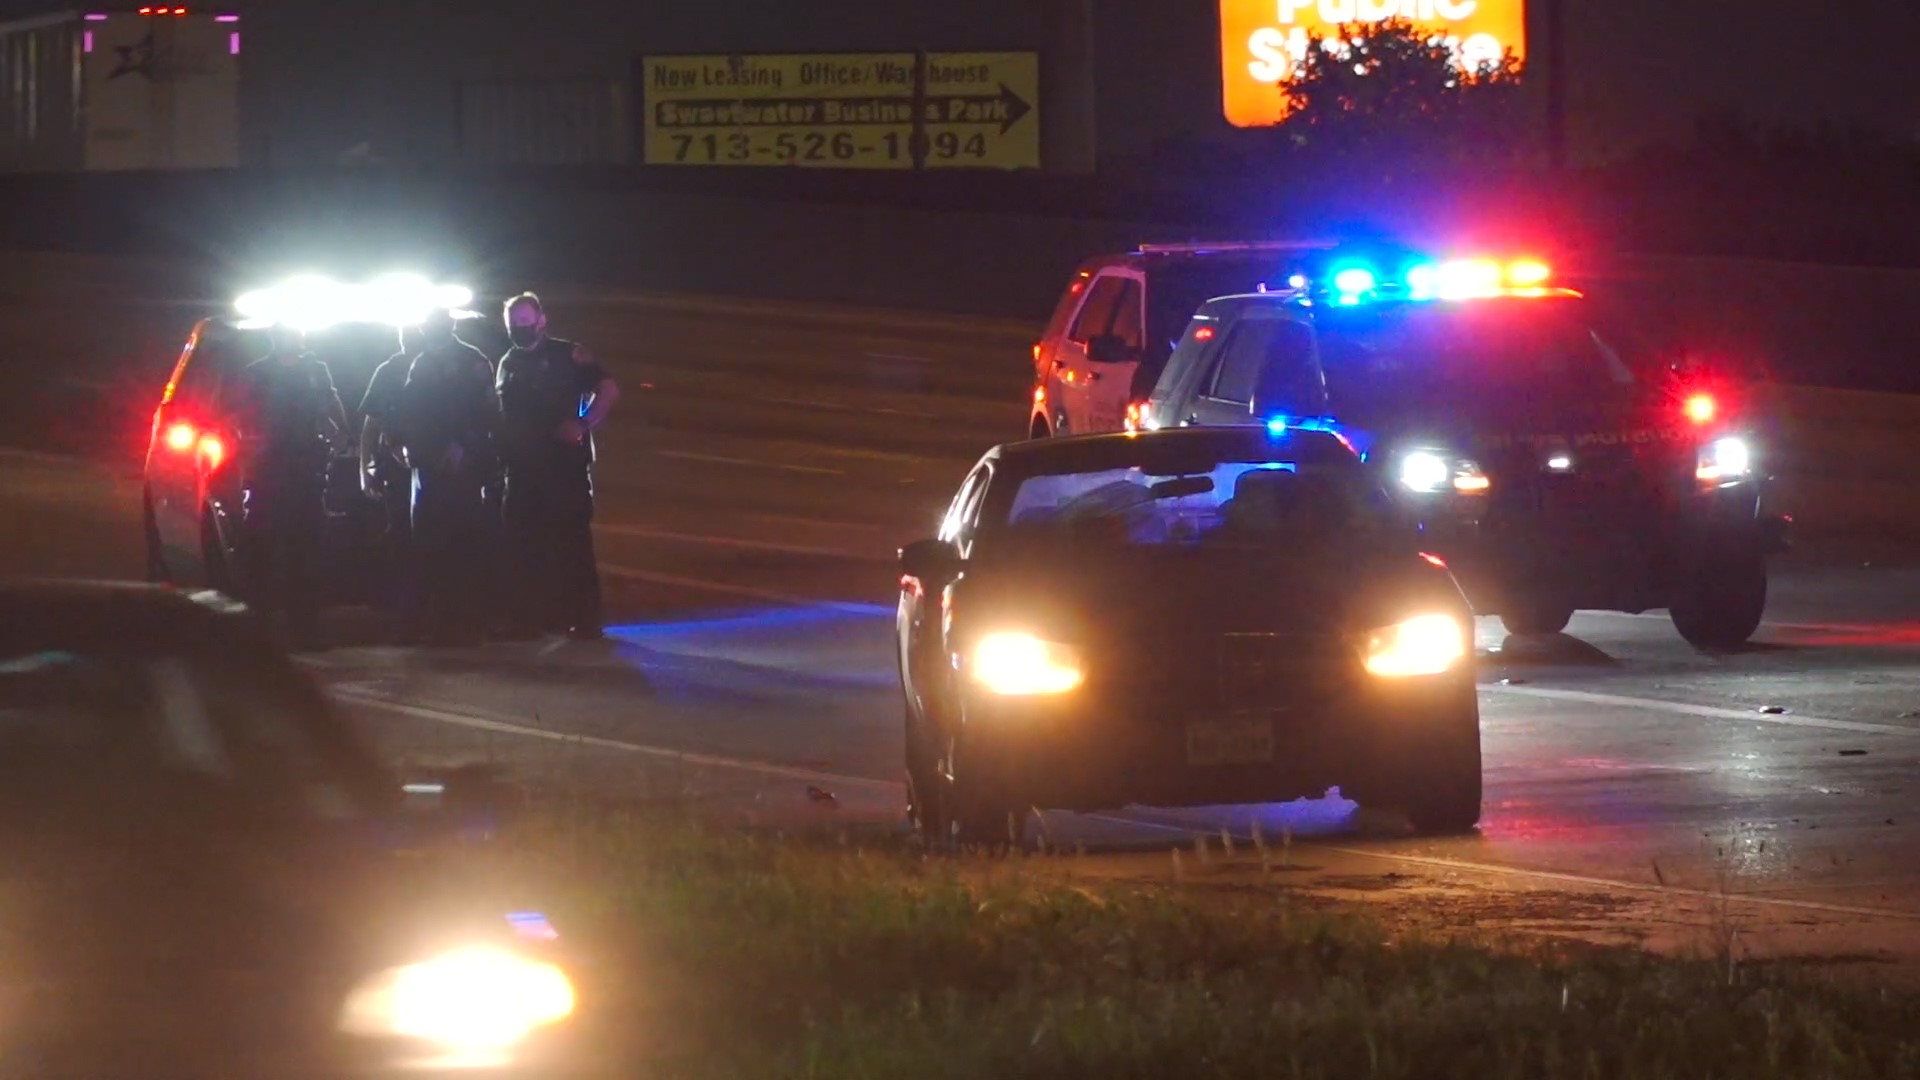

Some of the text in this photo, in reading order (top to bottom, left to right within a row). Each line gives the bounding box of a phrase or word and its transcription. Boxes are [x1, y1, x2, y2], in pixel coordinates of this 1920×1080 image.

[654, 61, 989, 87] Now Leasing Office/Warhouse
[823, 99, 940, 124] Busines
[948, 98, 1011, 123] Park
